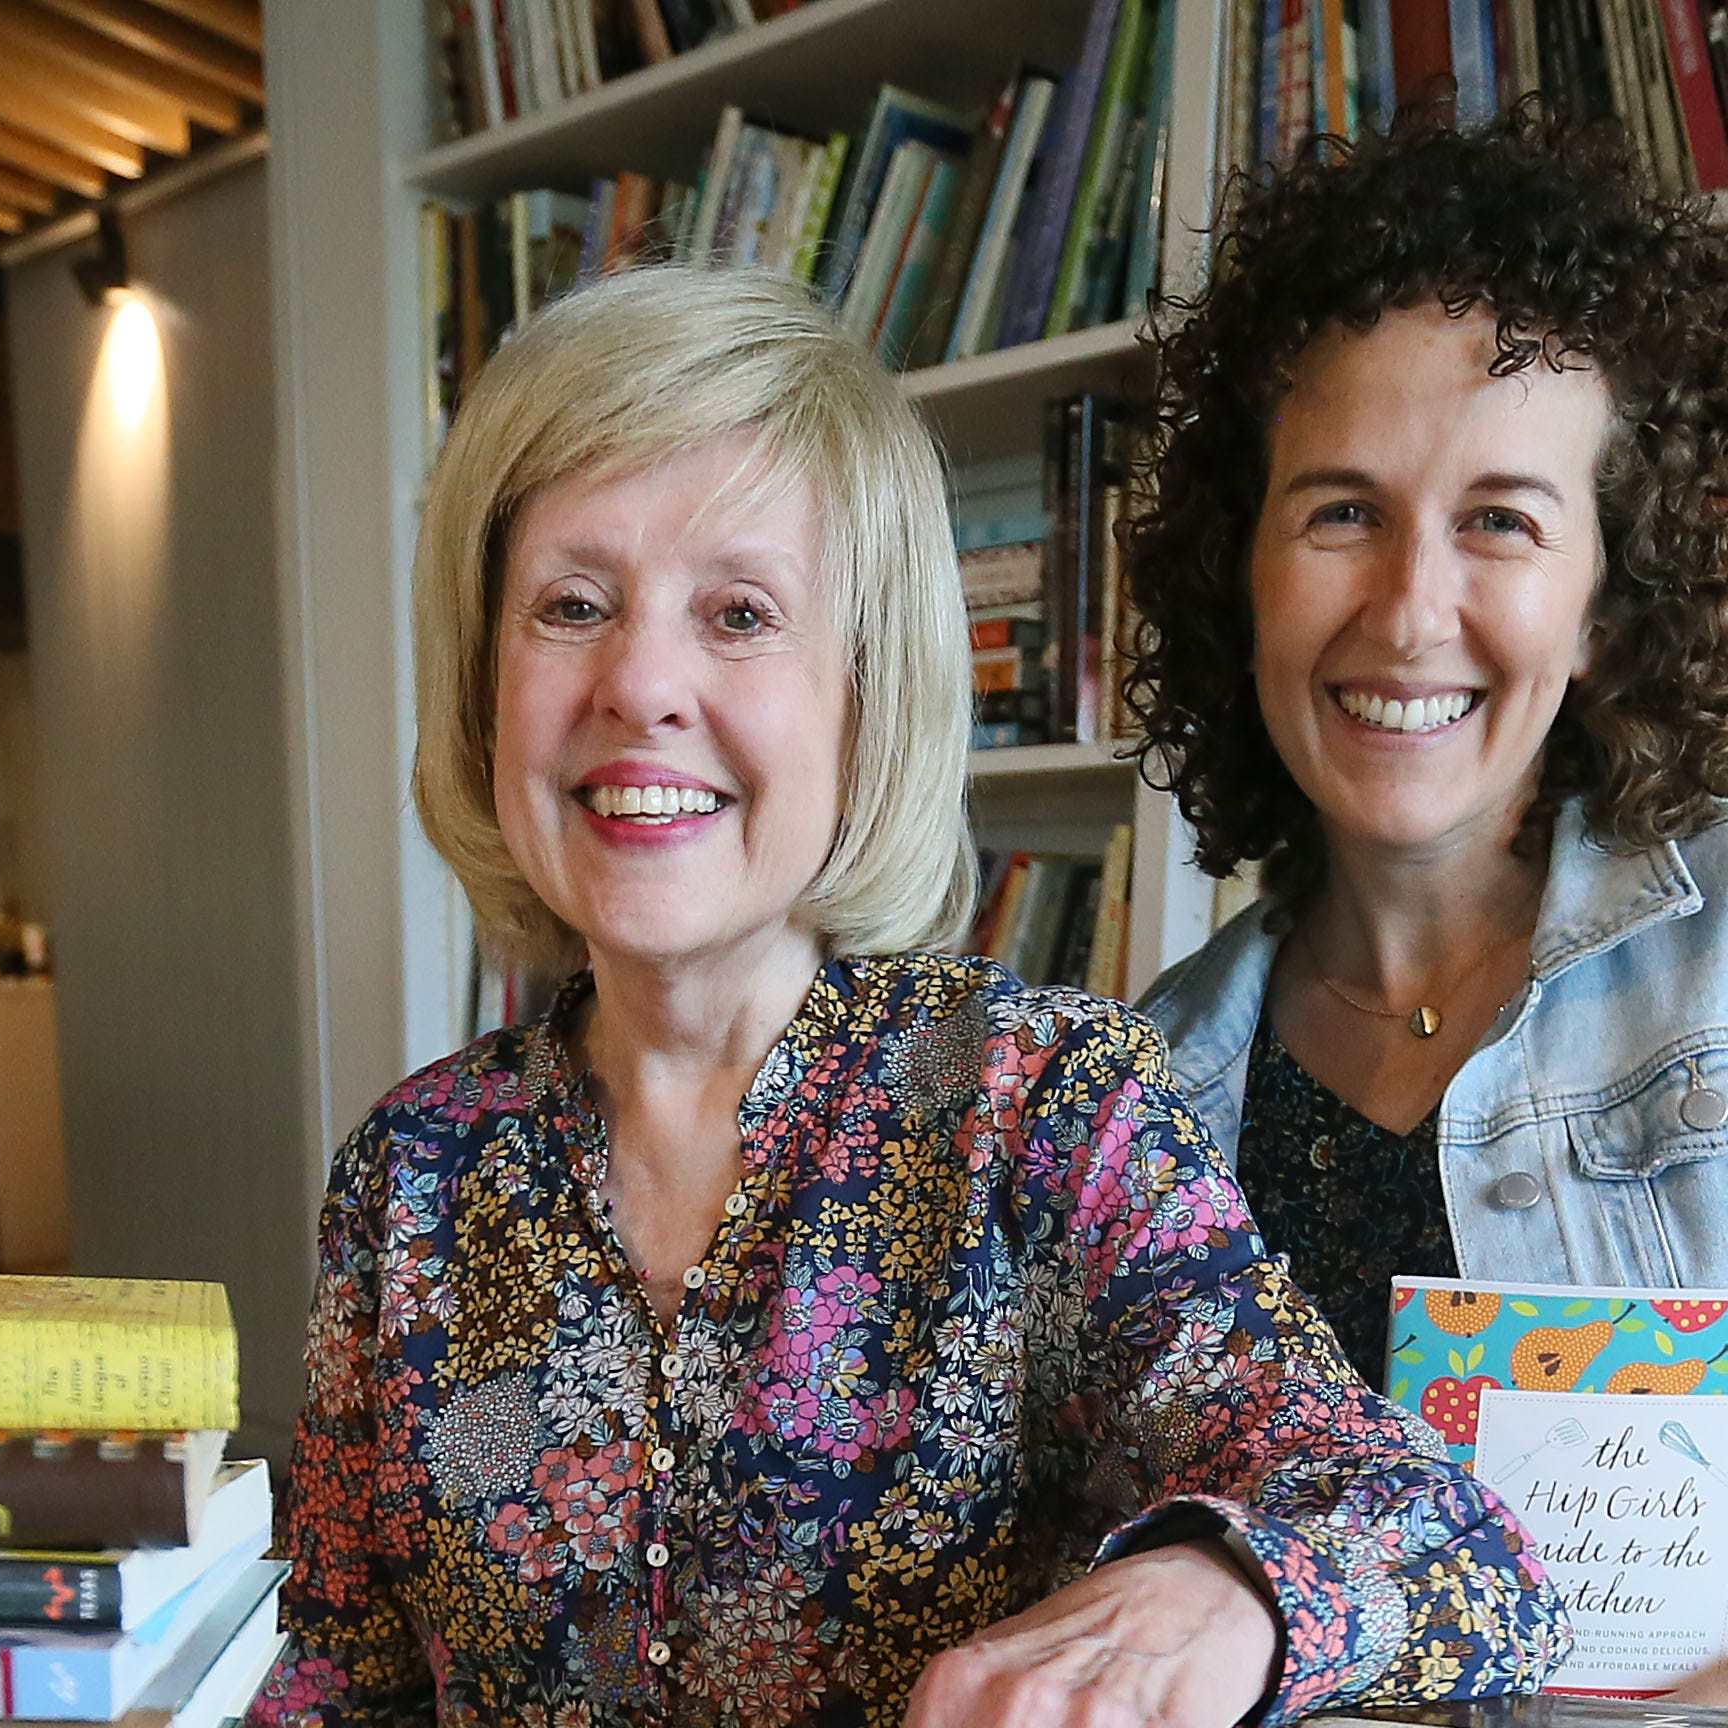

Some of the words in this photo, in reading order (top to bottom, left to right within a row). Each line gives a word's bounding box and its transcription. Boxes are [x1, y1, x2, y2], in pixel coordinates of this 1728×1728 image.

[1581, 1425, 1651, 1470] the
[1524, 1479, 1597, 1528] Hip
[1606, 1481, 1707, 1521] Girl's
[1618, 1537, 1651, 1565] to
[1650, 1524, 1712, 1568] the
[1648, 1630, 1708, 1640] APPROACH
[1599, 1645, 1649, 1655] COOKING
[1588, 1661, 1659, 1672] AFFORDABLE
[1662, 1662, 1699, 1672] MEALS
